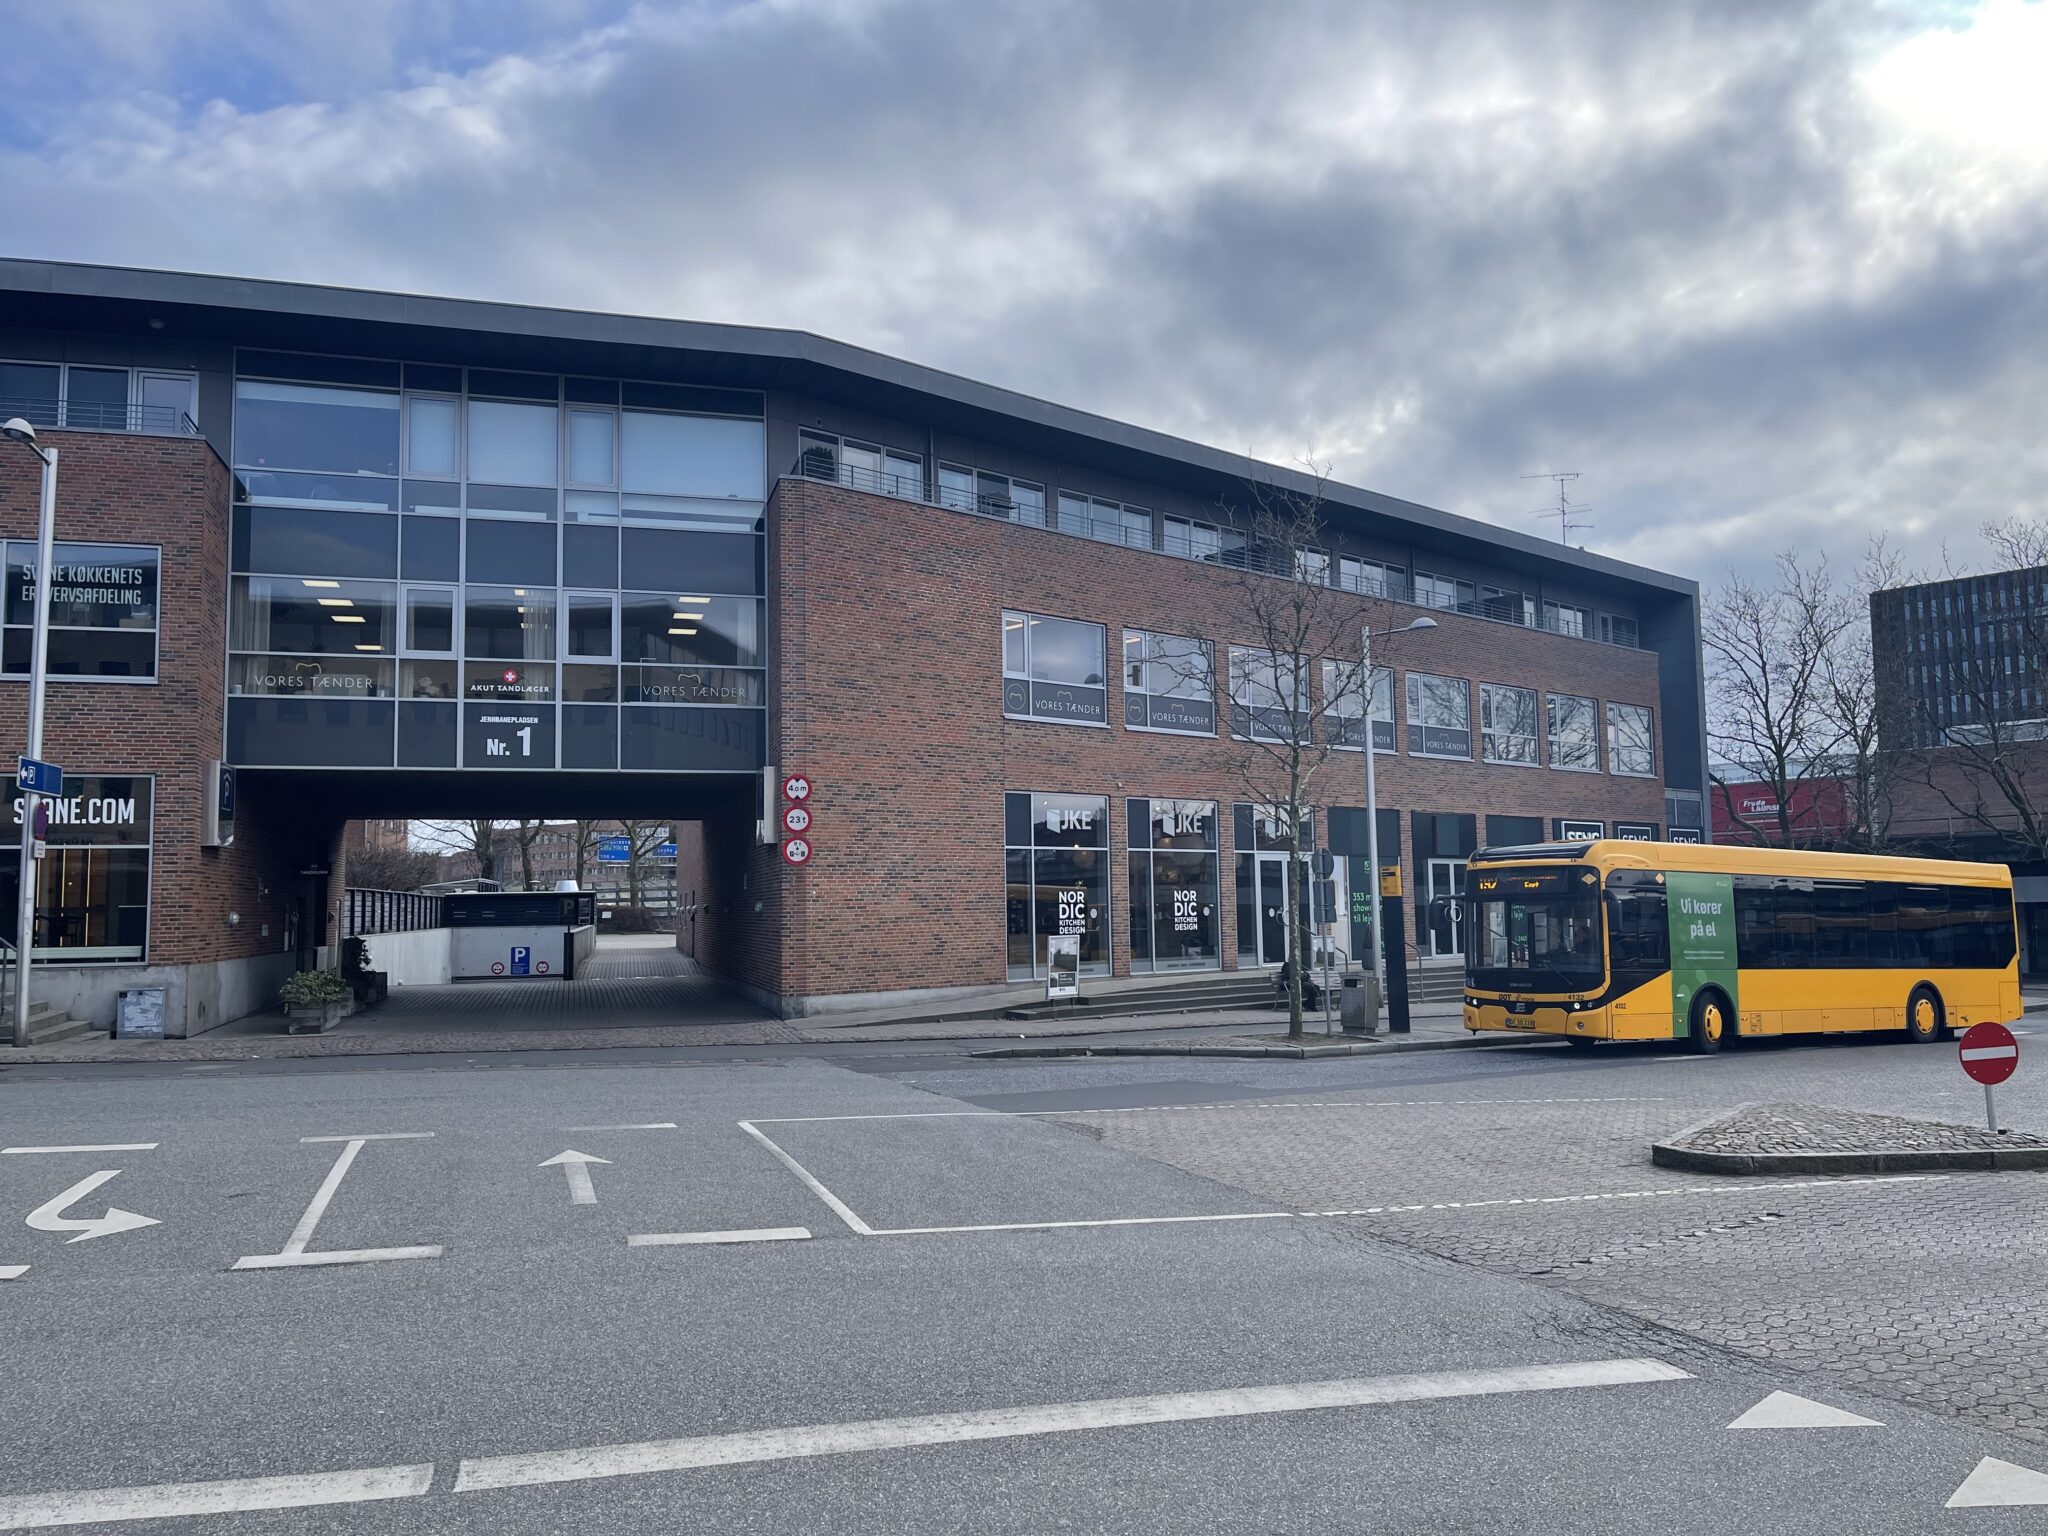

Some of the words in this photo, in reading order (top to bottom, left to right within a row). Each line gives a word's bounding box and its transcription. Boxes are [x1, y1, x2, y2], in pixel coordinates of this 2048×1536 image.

[23, 565, 65, 582] SVNE
[69, 566, 143, 585] KØKKENETS
[22, 586, 142, 605] ERVERVSAFDELING
[255, 675, 304, 687] VORES
[310, 676, 374, 689] TÆNDER
[643, 686, 685, 696] VORES
[692, 687, 746, 697] TÆNDER
[1035, 700, 1063, 711] VORES
[1066, 702, 1101, 715] TÆNDER
[480, 716, 539, 724] JERNBANEPLADSEN
[1152, 712, 1176, 723] VORES
[1179, 714, 1210, 726] TÆNDER
[486, 738, 510, 756] Nr.
[516, 726, 531, 757] 1
[1426, 740, 1444, 749] VORES
[1445, 742, 1467, 751] TÆNDER
[13, 798, 135, 824] SANE.COM
[1751, 804, 1780, 812] LAURS
[789, 815, 801, 824] 23
[802, 815, 807, 824] t
[1061, 809, 1092, 830] JKE
[1175, 814, 1203, 834] JKE
[1058, 891, 1085, 903] NOR
[1174, 890, 1197, 901] NOR
[1352, 892, 1364, 901] 353
[1059, 904, 1086, 919] DIC
[1174, 902, 1198, 917] DIC
[1680, 897, 1692, 914] Vi
[1693, 899, 1723, 915] kører
[1059, 926, 1086, 935] DESIGN
[1174, 923, 1198, 931] DESIGN
[1690, 919, 1704, 940] på
[1705, 921, 1717, 937] el
[514, 947, 526, 963] P
[1614, 1002, 1627, 1010] 4132
